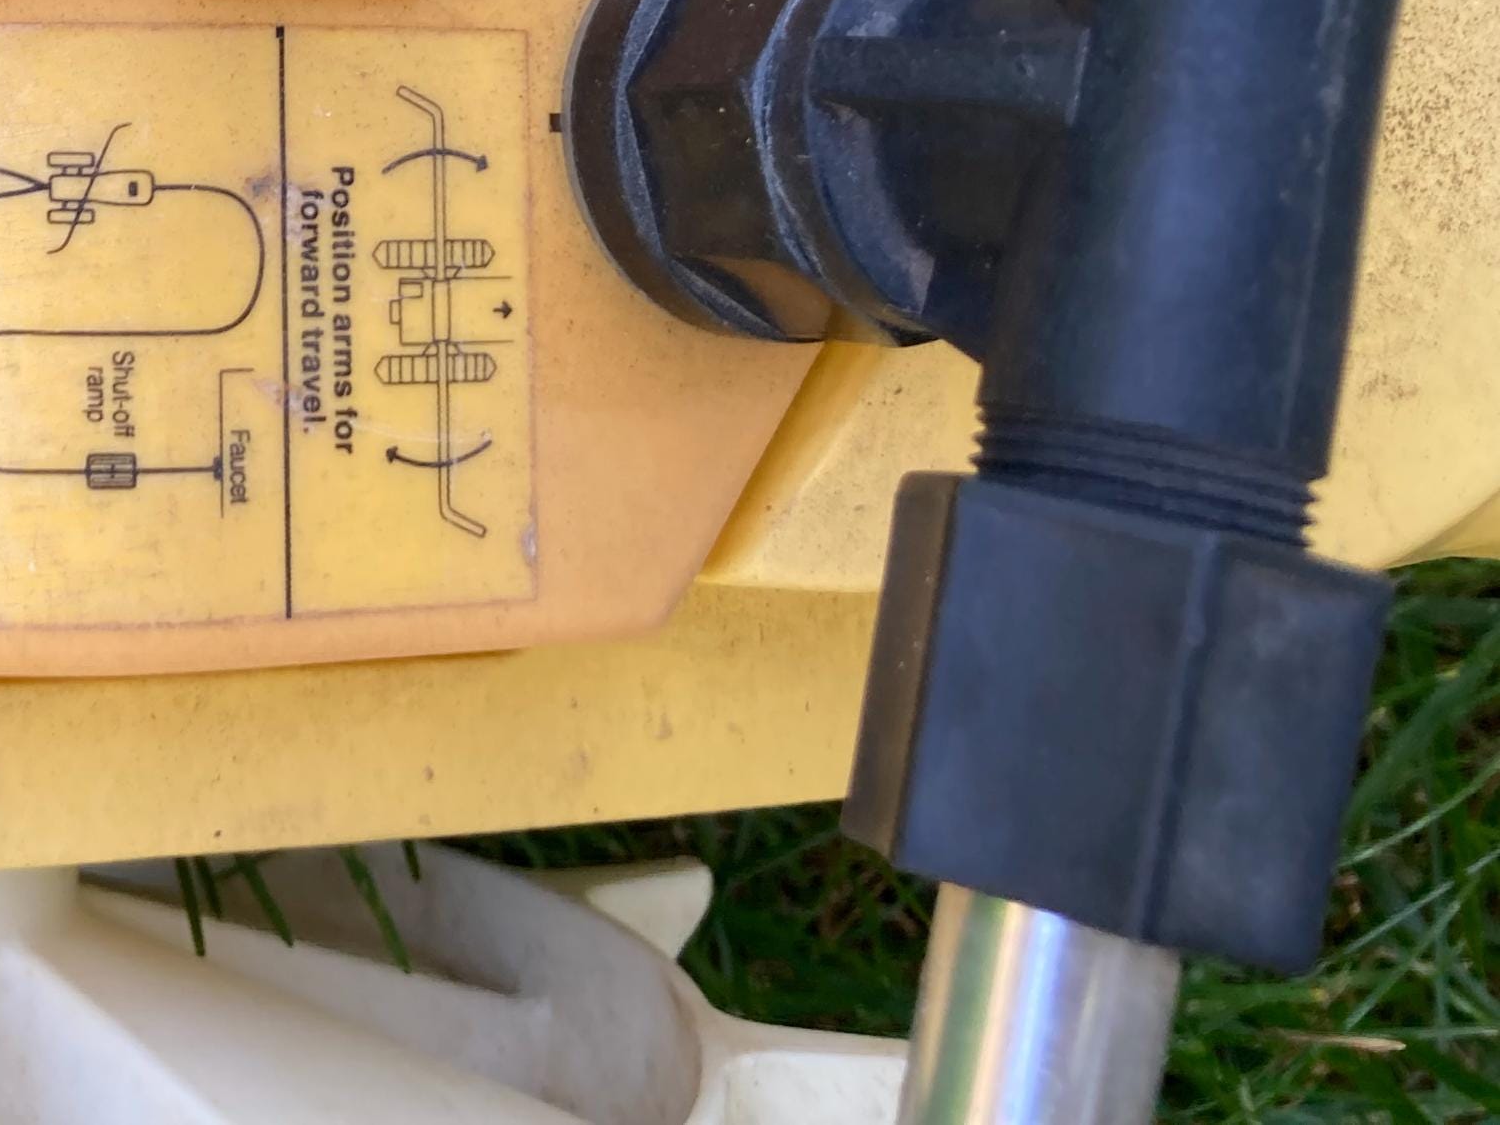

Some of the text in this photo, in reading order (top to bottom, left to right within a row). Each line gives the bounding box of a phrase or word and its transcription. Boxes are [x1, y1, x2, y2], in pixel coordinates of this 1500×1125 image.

[300, 189, 327, 434] forward travel.
[331, 166, 358, 454] Position arms for
[82, 366, 104, 423] ramp
[112, 350, 136, 438] Shut-off
[229, 429, 251, 505] Faucet
